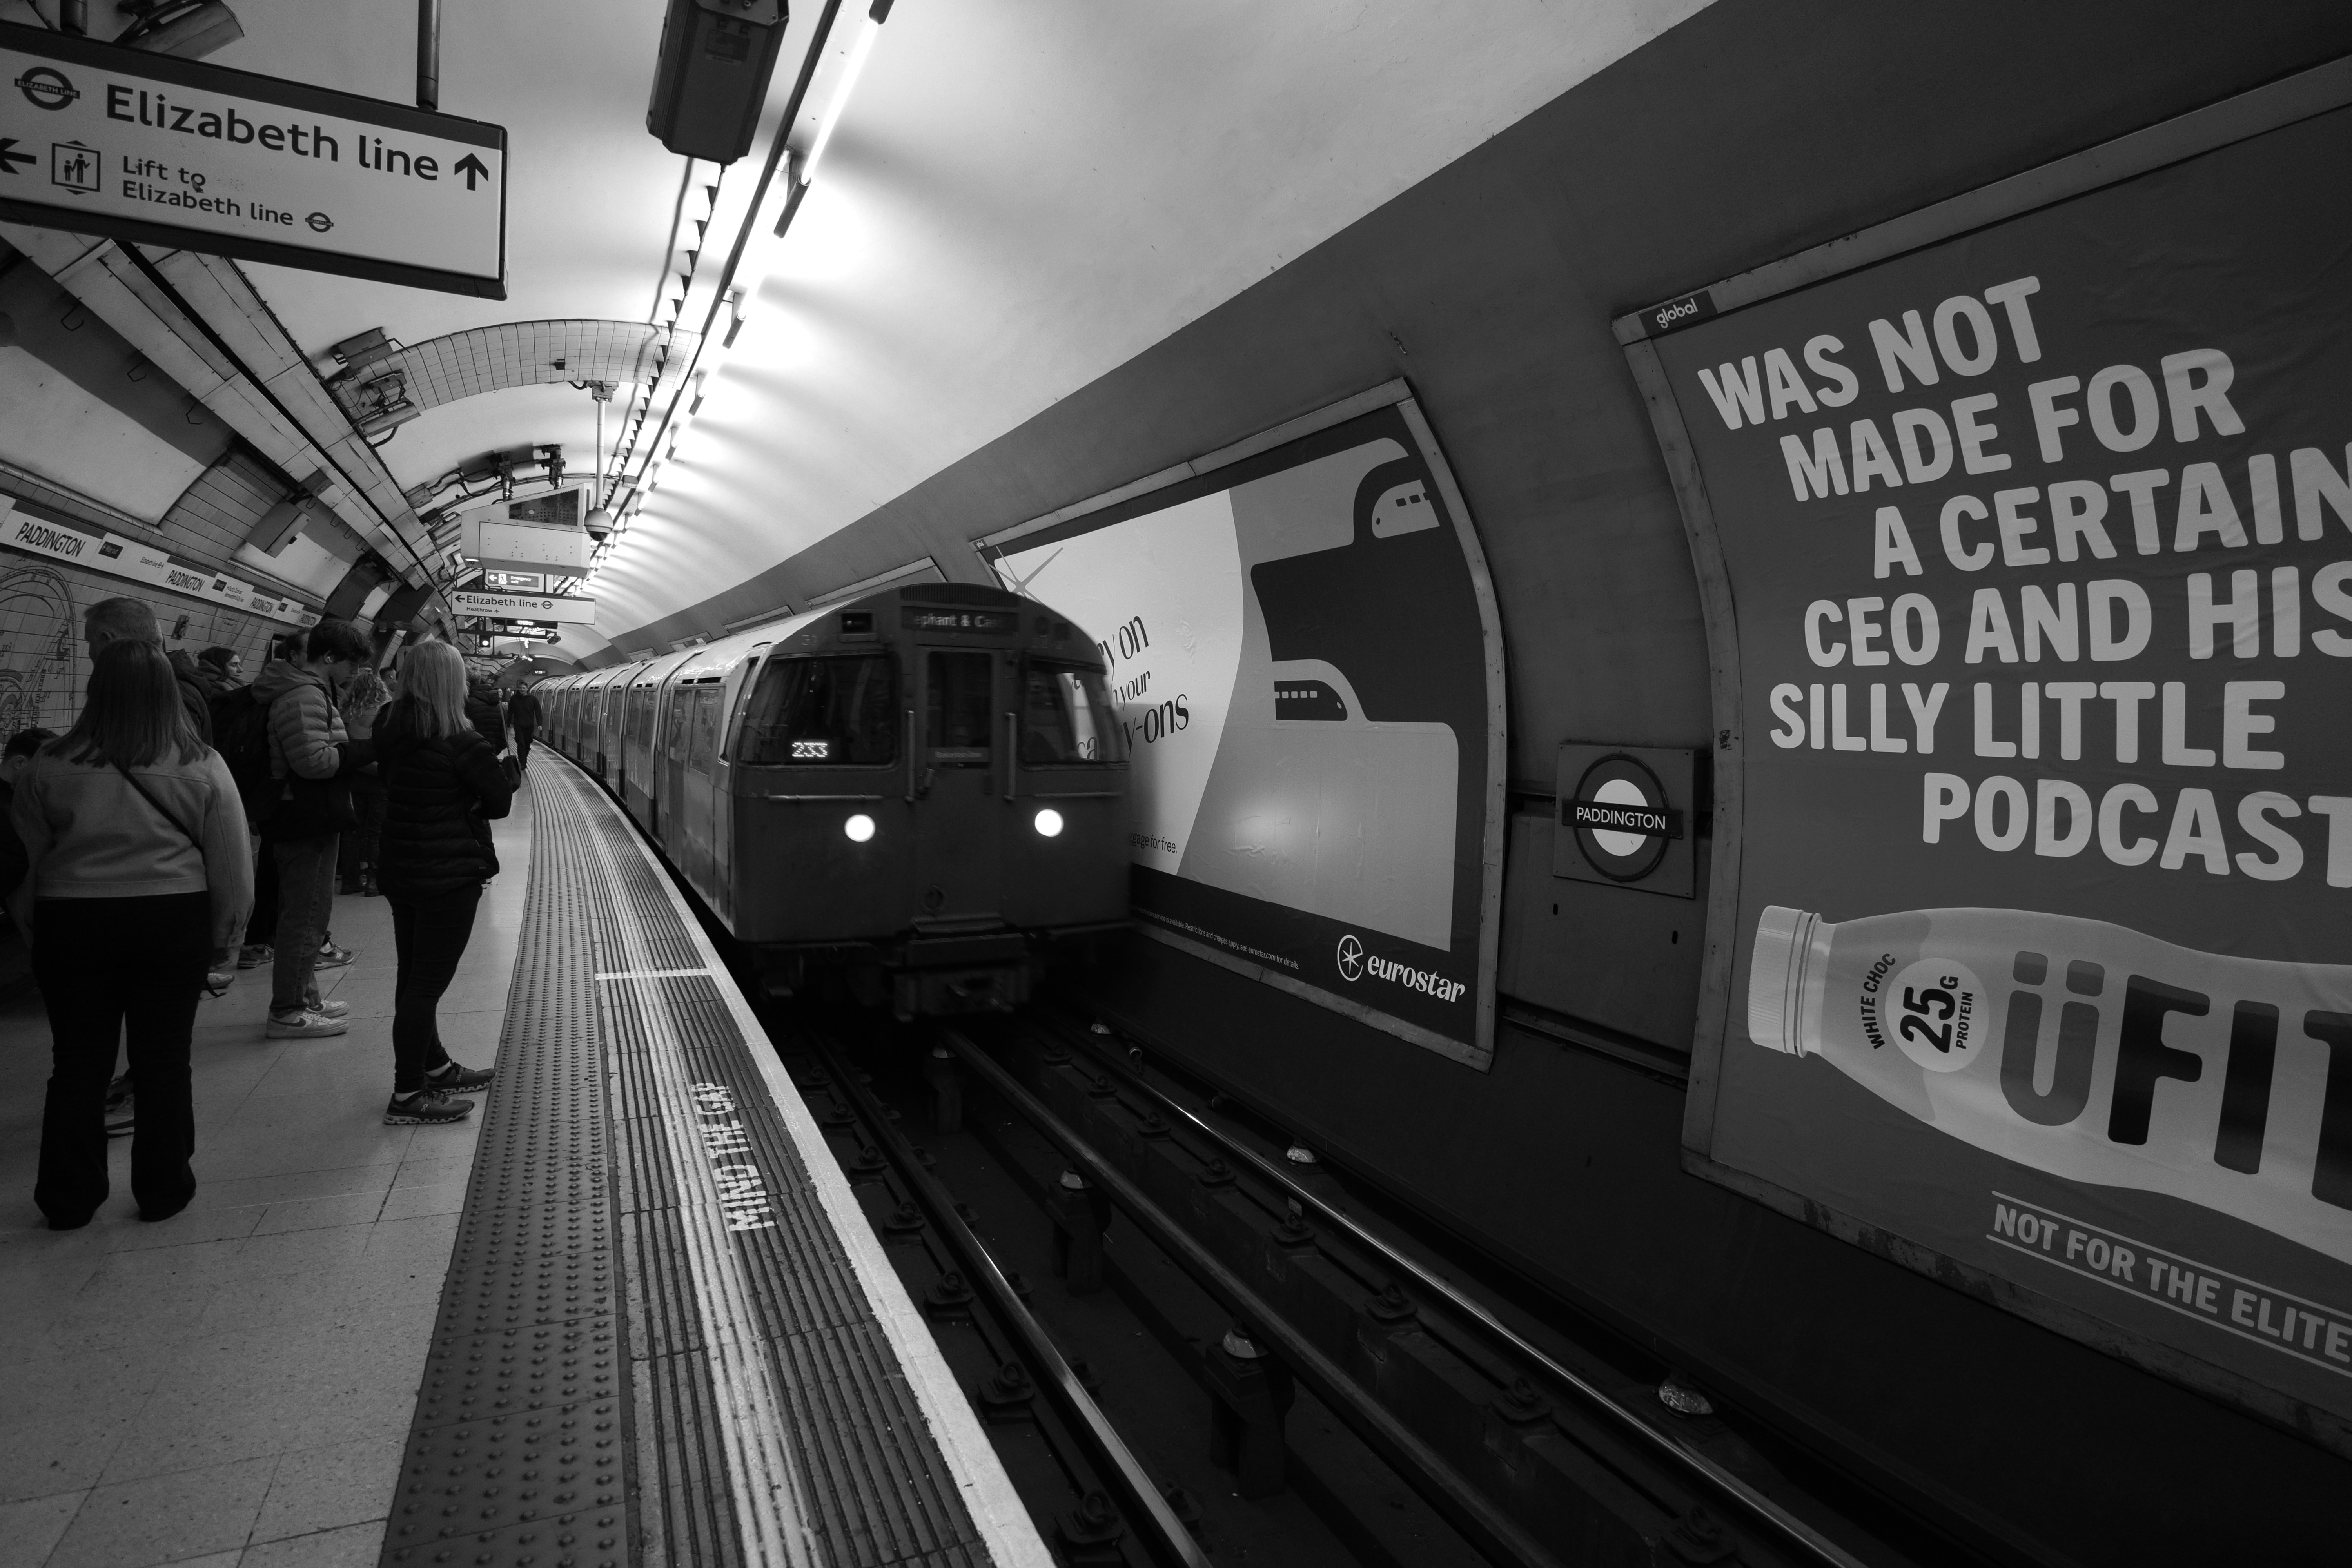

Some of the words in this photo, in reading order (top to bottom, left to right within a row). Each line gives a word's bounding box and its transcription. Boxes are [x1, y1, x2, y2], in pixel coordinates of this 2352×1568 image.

[18, 80, 58, 93] ELIZABETH
[60, 89, 78, 97] LINE
[107, 83, 338, 162] Elizabeth
[359, 135, 439, 181] line
[123, 156, 168, 180] Lift
[178, 165, 206, 187] to
[123, 180, 240, 217] Elizabeth
[250, 202, 294, 227] line
[1655, 298, 1699, 328] global
[1697, 334, 1859, 430] WAS
[1868, 276, 2042, 394] NOT
[1779, 393, 2012, 502] MADE
[2027, 348, 2246, 463] FOR
[1874, 506, 1923, 579] A
[1939, 442, 2352, 571] CERTAIN
[15, 522, 86, 558] PADDINGTON
[165, 570, 206, 592] PADDINGTON
[467, 595, 515, 606] Elizabeth
[519, 599, 537, 608] line
[960, 615, 971, 627] &
[1804, 593, 1940, 667] CEO
[1964, 579, 2152, 664] AND
[2187, 561, 2352, 659] HIS
[1119, 615, 1149, 660] on
[1120, 670, 1151, 711] your
[1769, 682, 1949, 755] SILLY
[1973, 680, 2285, 770] LITTLE
[792, 742, 827, 757] 233
[1577, 807, 1666, 830] PADDINGTON
[1922, 772, 2352, 888] PODCAST
[1151, 835, 1160, 849] for
[1161, 837, 1177, 854] free.
[1154, 913, 1166, 922] service
[1169, 918, 1185, 929] available.
[1185, 923, 1206, 936] Restrictions
[1213, 934, 1228, 945] charges
[1228, 940, 1240, 950] apply,
[1248, 947, 1276, 962] eurostar.com
[1283, 957, 1300, 970] details.
[1367, 954, 1465, 1003] eurostar
[1863, 953, 1897, 994] CHOC
[1860, 996, 1886, 1050] WHITE
[1955, 991, 1974, 1050] PROTEIN
[699, 1120, 753, 1159] THE
[713, 1164, 775, 1232] MIND
[1993, 1203, 2060, 1252] NOT
[2066, 1230, 2135, 1283] FOR
[2147, 1256, 2221, 1315] THE
[2231, 1288, 2352, 1363] ELITE
